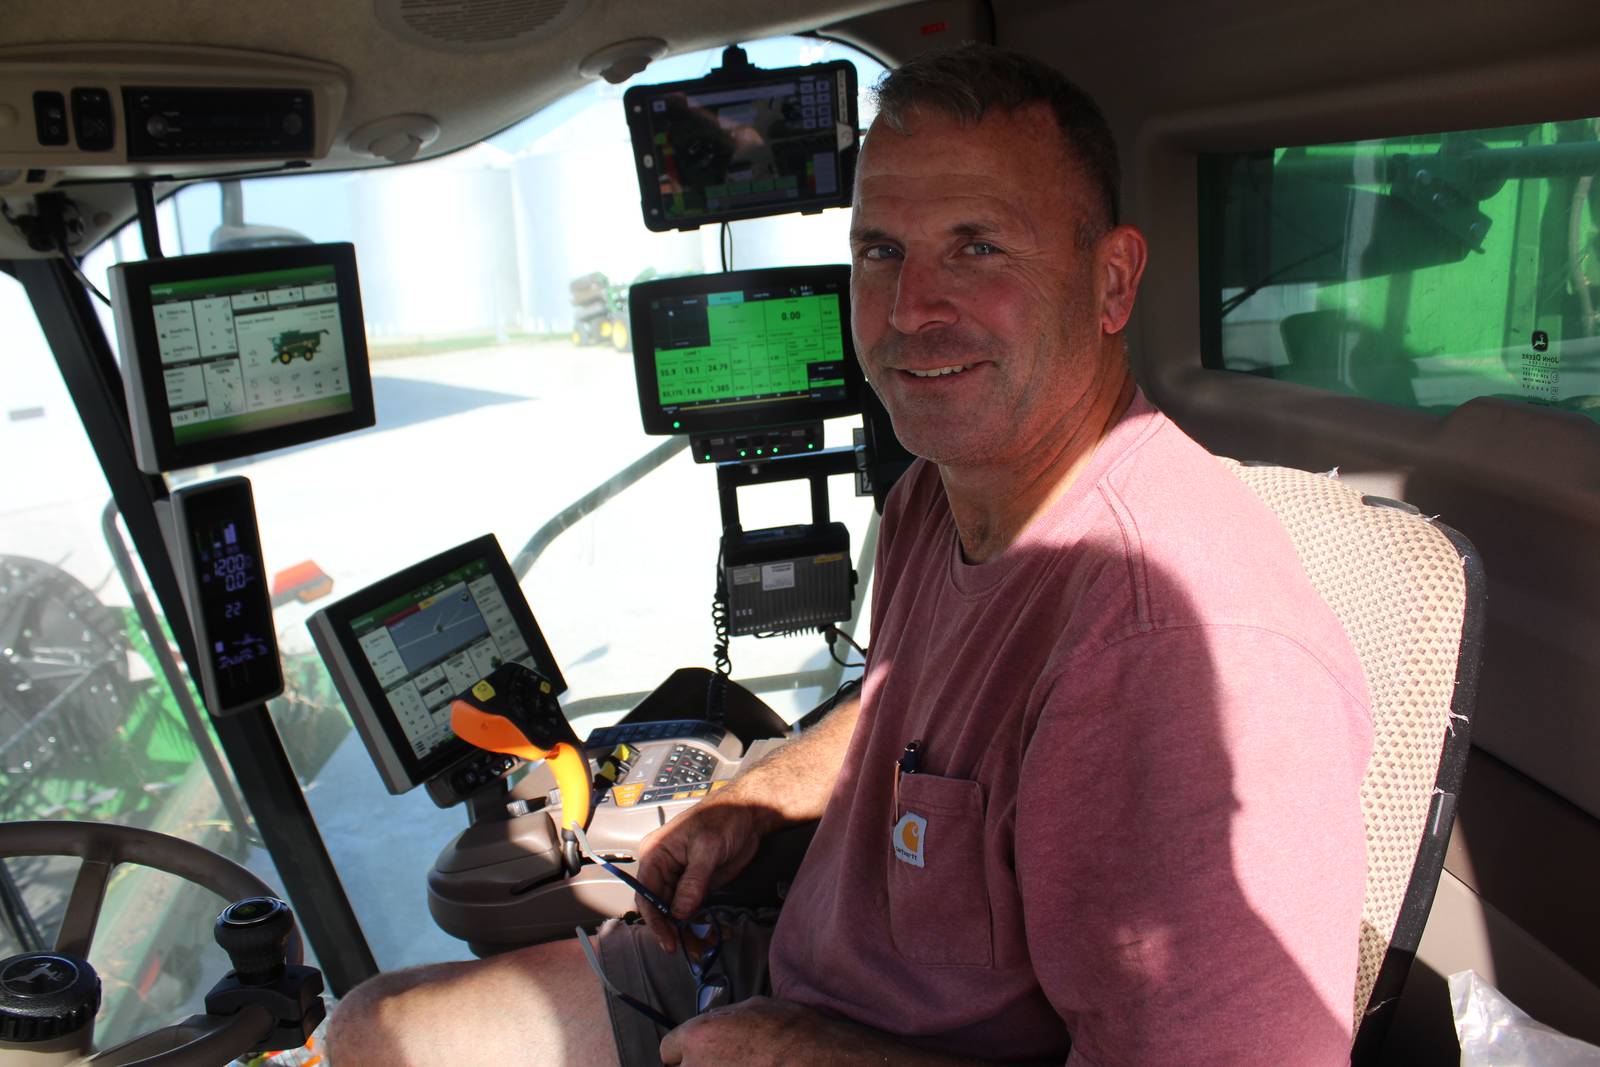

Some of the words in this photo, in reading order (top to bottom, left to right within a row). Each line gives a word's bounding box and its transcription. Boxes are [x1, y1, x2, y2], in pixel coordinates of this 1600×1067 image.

[781, 311, 801, 321] 0.00
[214, 554, 245, 577] 1200
[225, 602, 241, 618] 22
